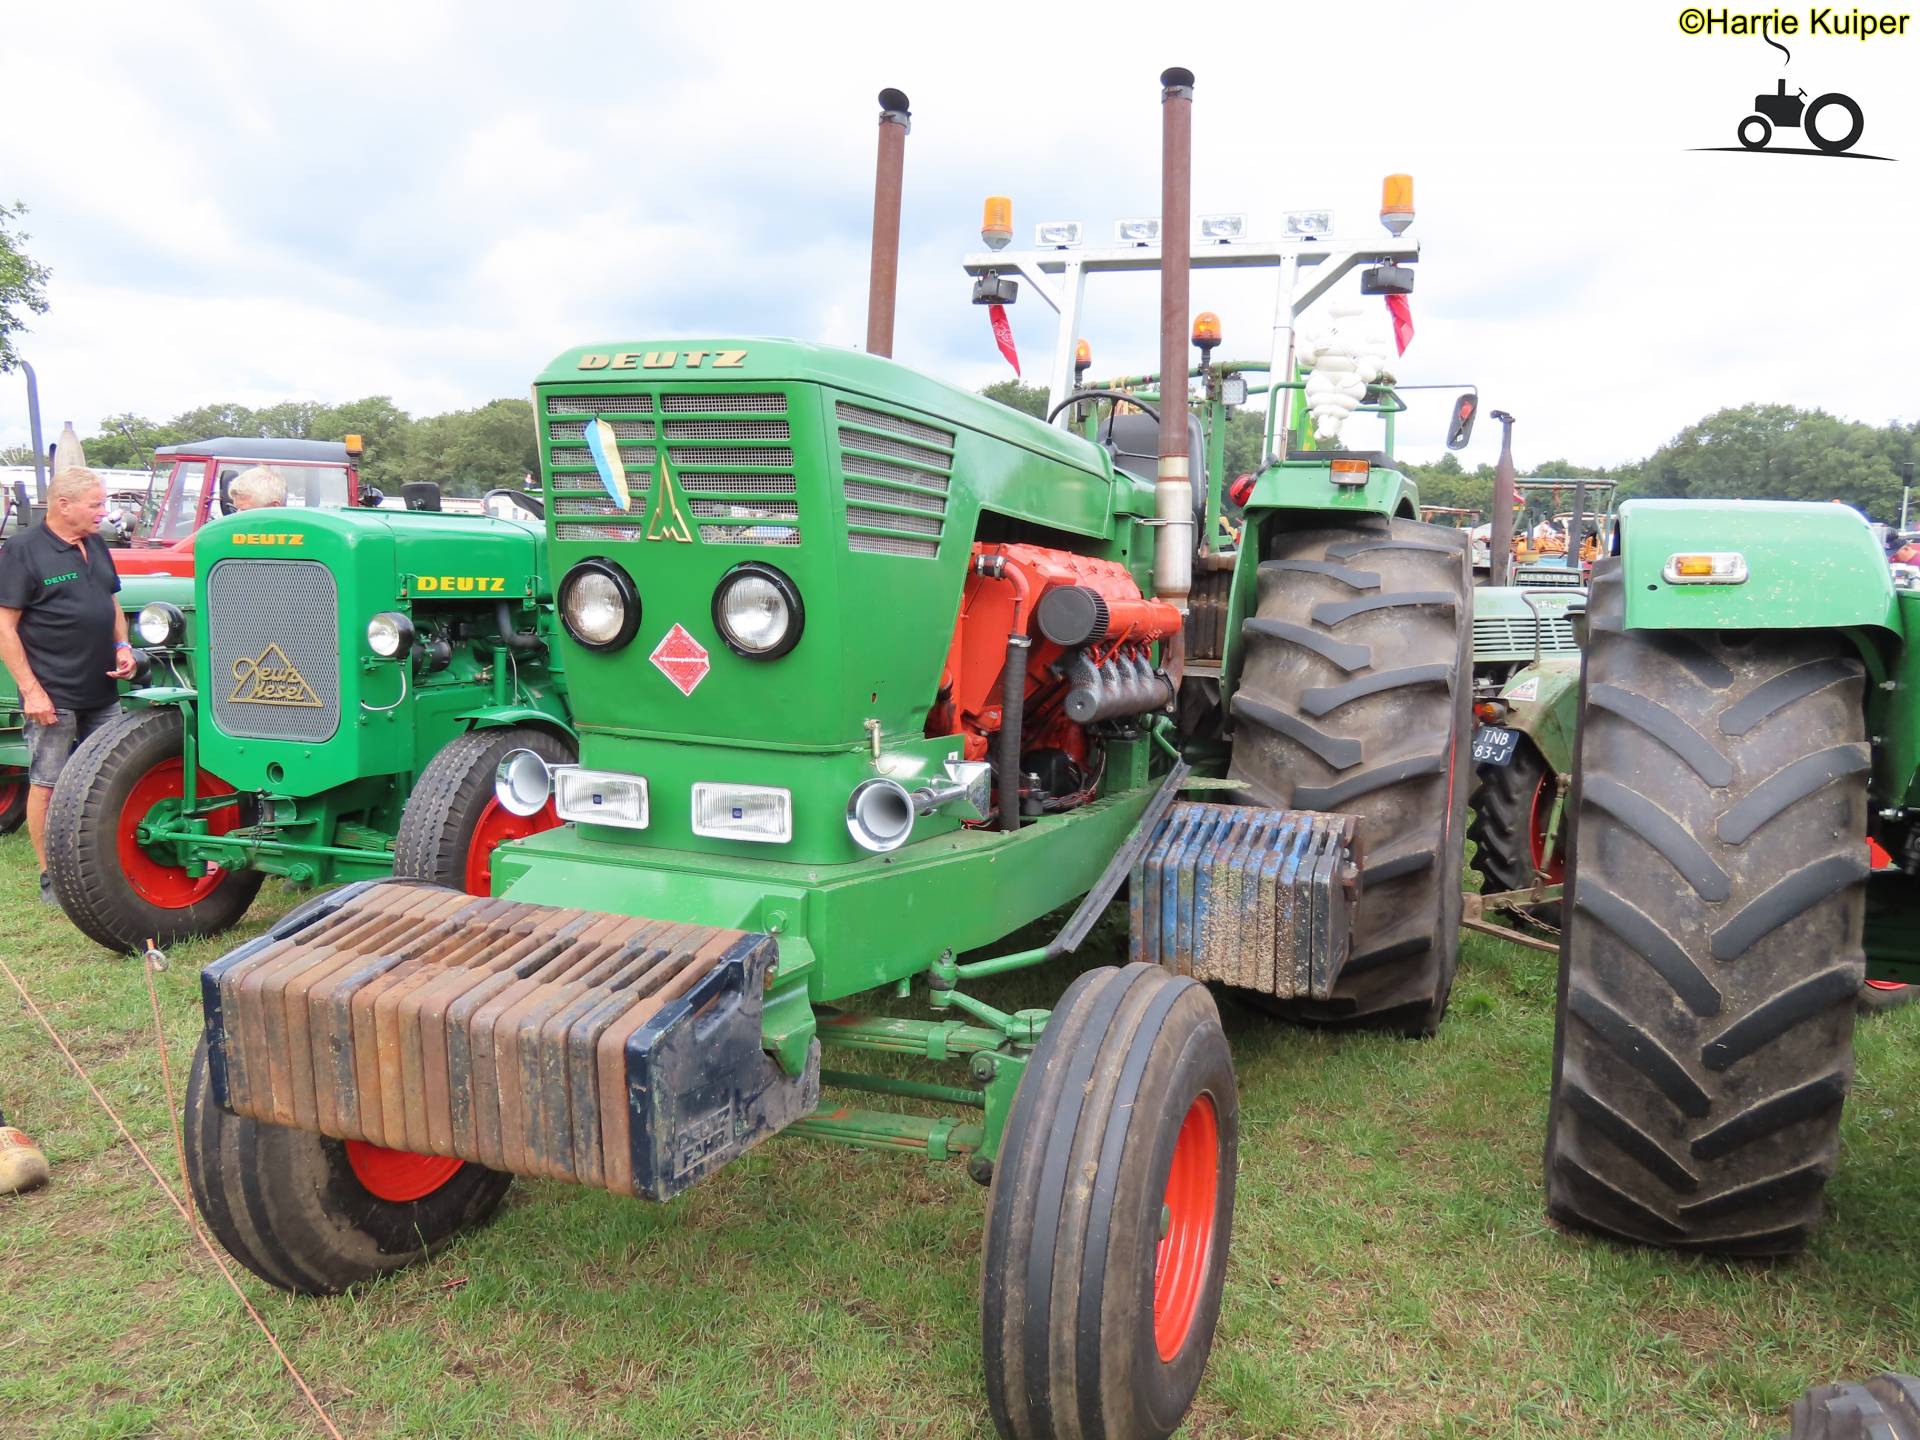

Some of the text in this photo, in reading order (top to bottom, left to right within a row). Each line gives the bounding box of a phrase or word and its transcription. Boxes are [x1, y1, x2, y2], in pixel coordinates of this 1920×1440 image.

[577, 350, 748, 371] DEUTZ
[232, 534, 304, 546] DEUTZ
[43, 572, 79, 586] DEUTZ
[417, 576, 505, 592] DEUTZ
[1519, 573, 1577, 582] HANOMAG
[1483, 729, 1510, 746] TNB
[1474, 745, 1506, 762] 83-J
